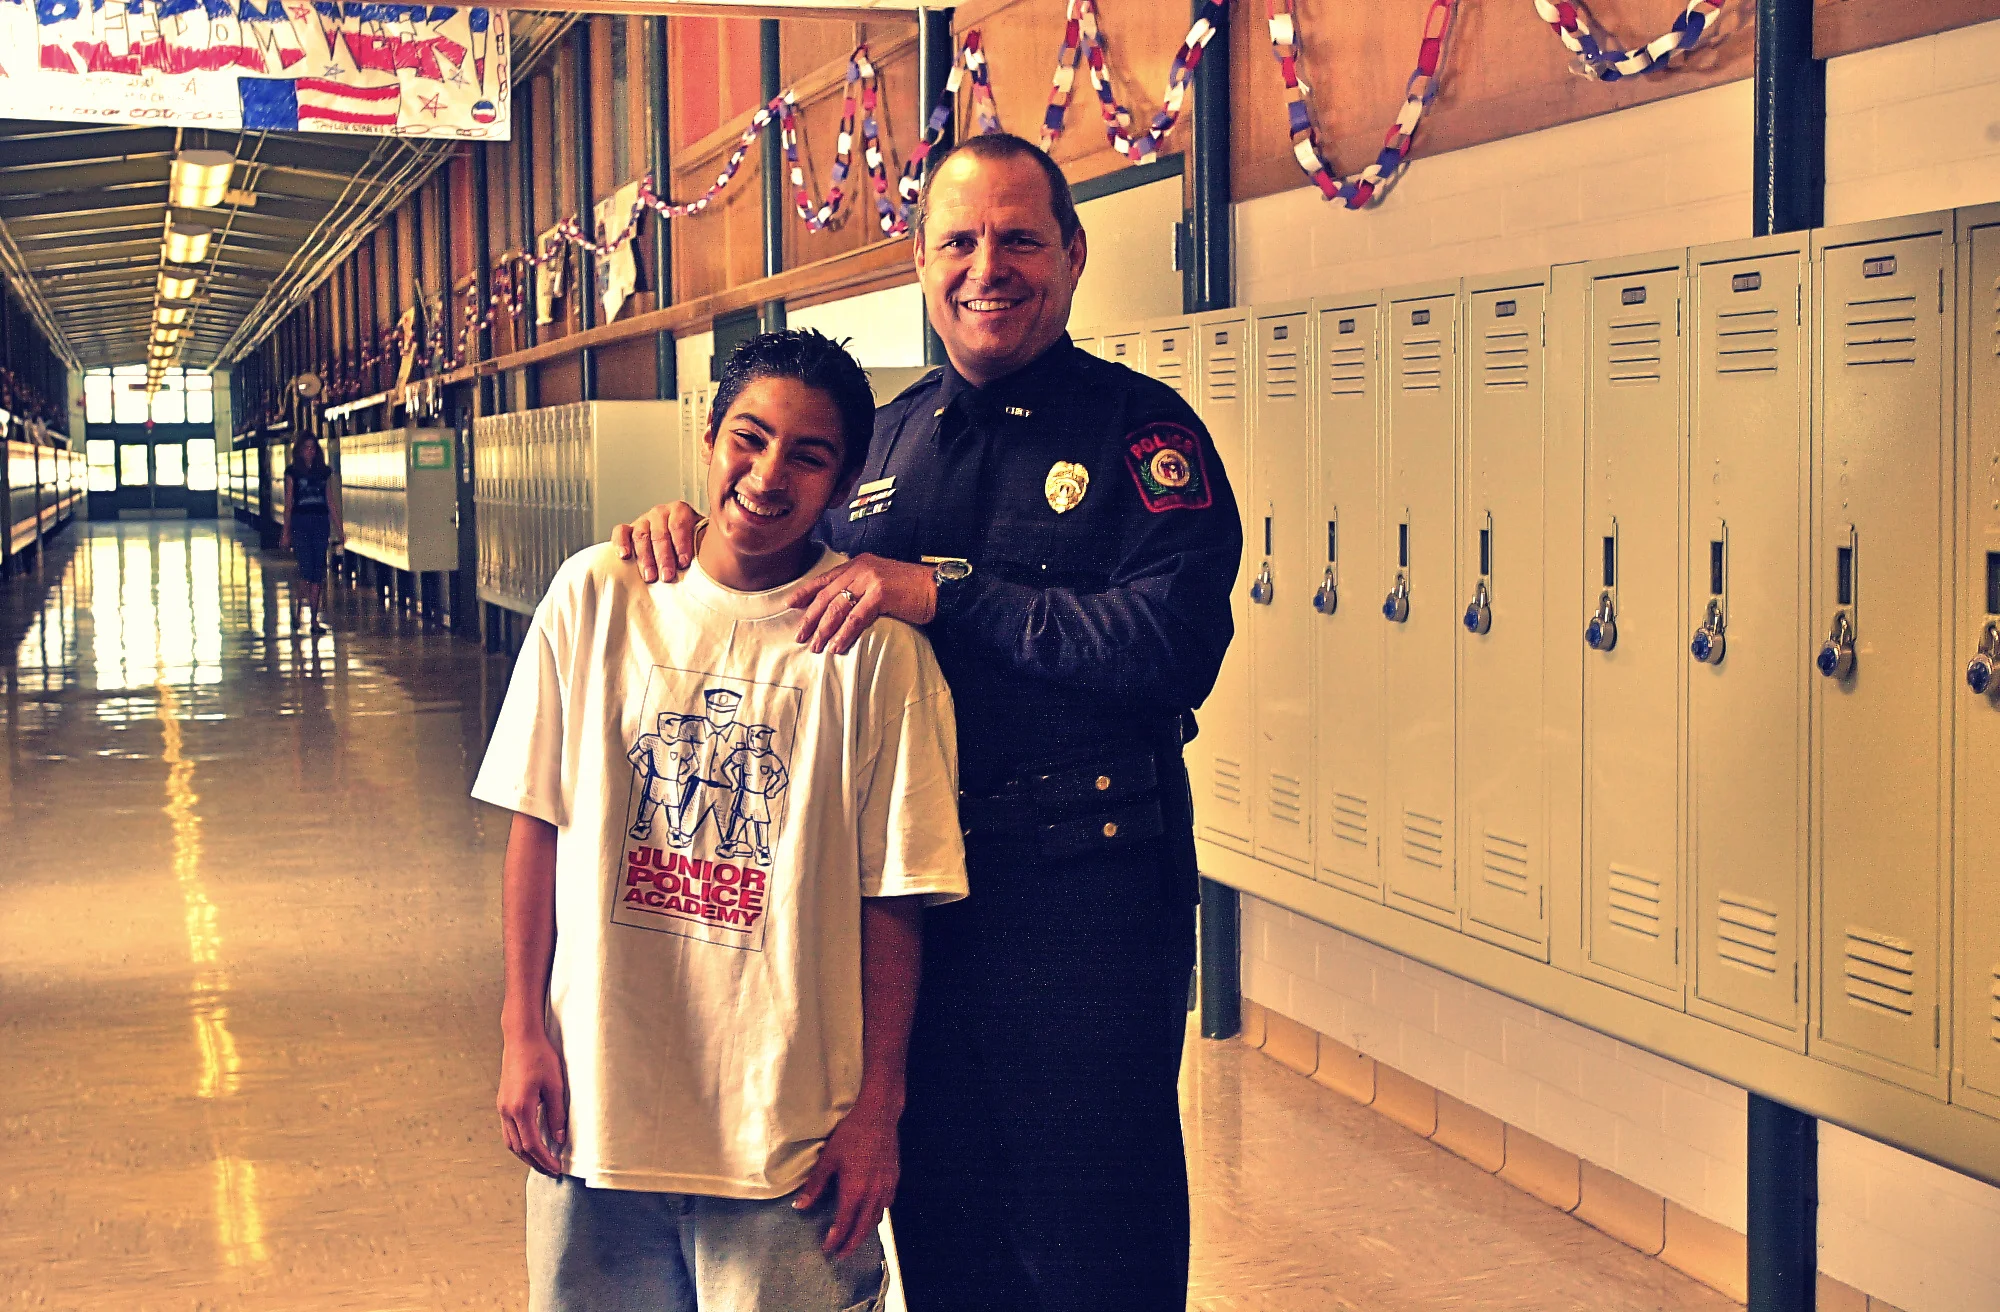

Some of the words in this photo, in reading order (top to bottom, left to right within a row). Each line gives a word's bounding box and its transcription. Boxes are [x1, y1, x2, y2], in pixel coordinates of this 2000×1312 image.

[626, 866, 764, 912] POLICE
[628, 845, 767, 891] JUNIOR
[622, 888, 762, 927] ACADEMY
